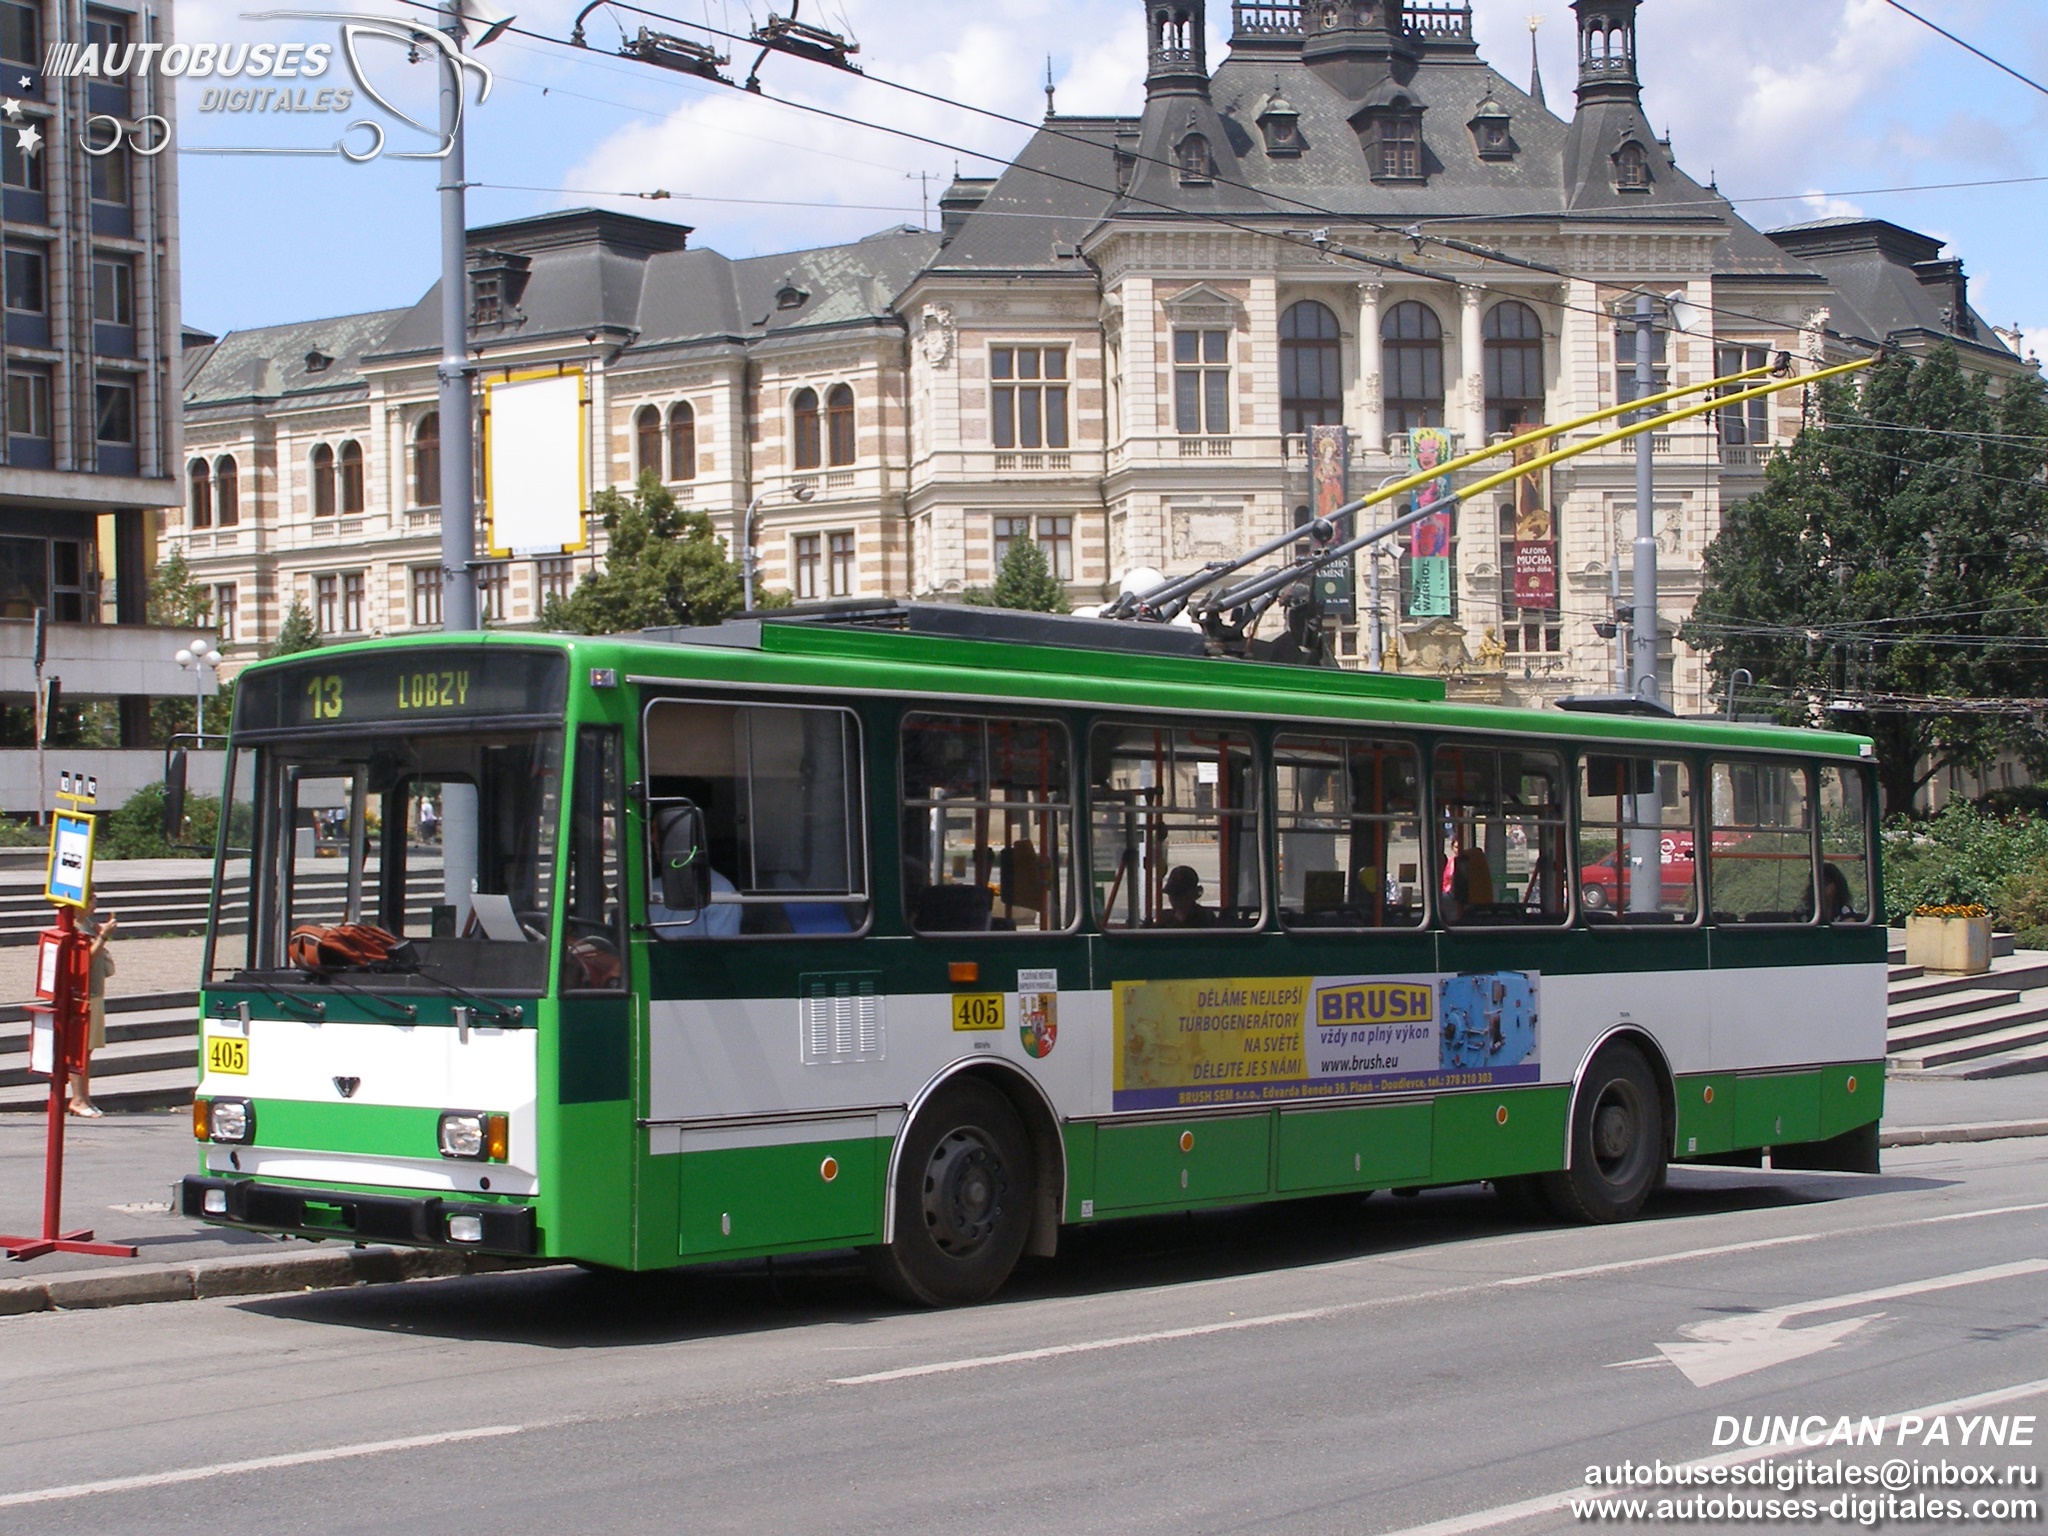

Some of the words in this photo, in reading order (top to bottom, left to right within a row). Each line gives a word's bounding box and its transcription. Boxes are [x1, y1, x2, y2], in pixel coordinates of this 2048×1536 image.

[1516, 555, 1552, 565] MUCHA
[1521, 546, 1548, 555] ALFONS
[1413, 579, 1421, 611] ANDY
[1422, 560, 1431, 612] WARHOL
[308, 675, 342, 718] 13
[399, 671, 469, 709] LOBZY
[1198, 988, 1247, 1007] DĚLÁME
[1250, 986, 1302, 1005] NEJLEPŠÍ
[1322, 989, 1426, 1019] BRUSH
[958, 999, 998, 1024] 405
[1179, 1011, 1299, 1032] TURBOGENERÁTORY
[1243, 1037, 1261, 1053] NA
[1263, 1032, 1299, 1053] SVĚTĚ
[1320, 1028, 1348, 1047] vždy
[1350, 1030, 1364, 1043] na
[1367, 1025, 1394, 1046] plný
[1395, 1024, 1430, 1044] výkon
[211, 1042, 244, 1069] 405
[1321, 1054, 1398, 1072] www.brush.eu
[1194, 1061, 1243, 1079] DĚLEJTE
[1245, 1061, 1258, 1076] JE
[1260, 1060, 1268, 1076] S
[1179, 1091, 1211, 1105] BRUSH
[1213, 1089, 1234, 1102] SEM
[1262, 1085, 1300, 1099] Edvarda
[1301, 1083, 1333, 1097] Beneše
[1350, 1080, 1373, 1093] Plzeň
[1445, 1075, 1460, 1087] 378
[1462, 1073, 1476, 1085] 210
